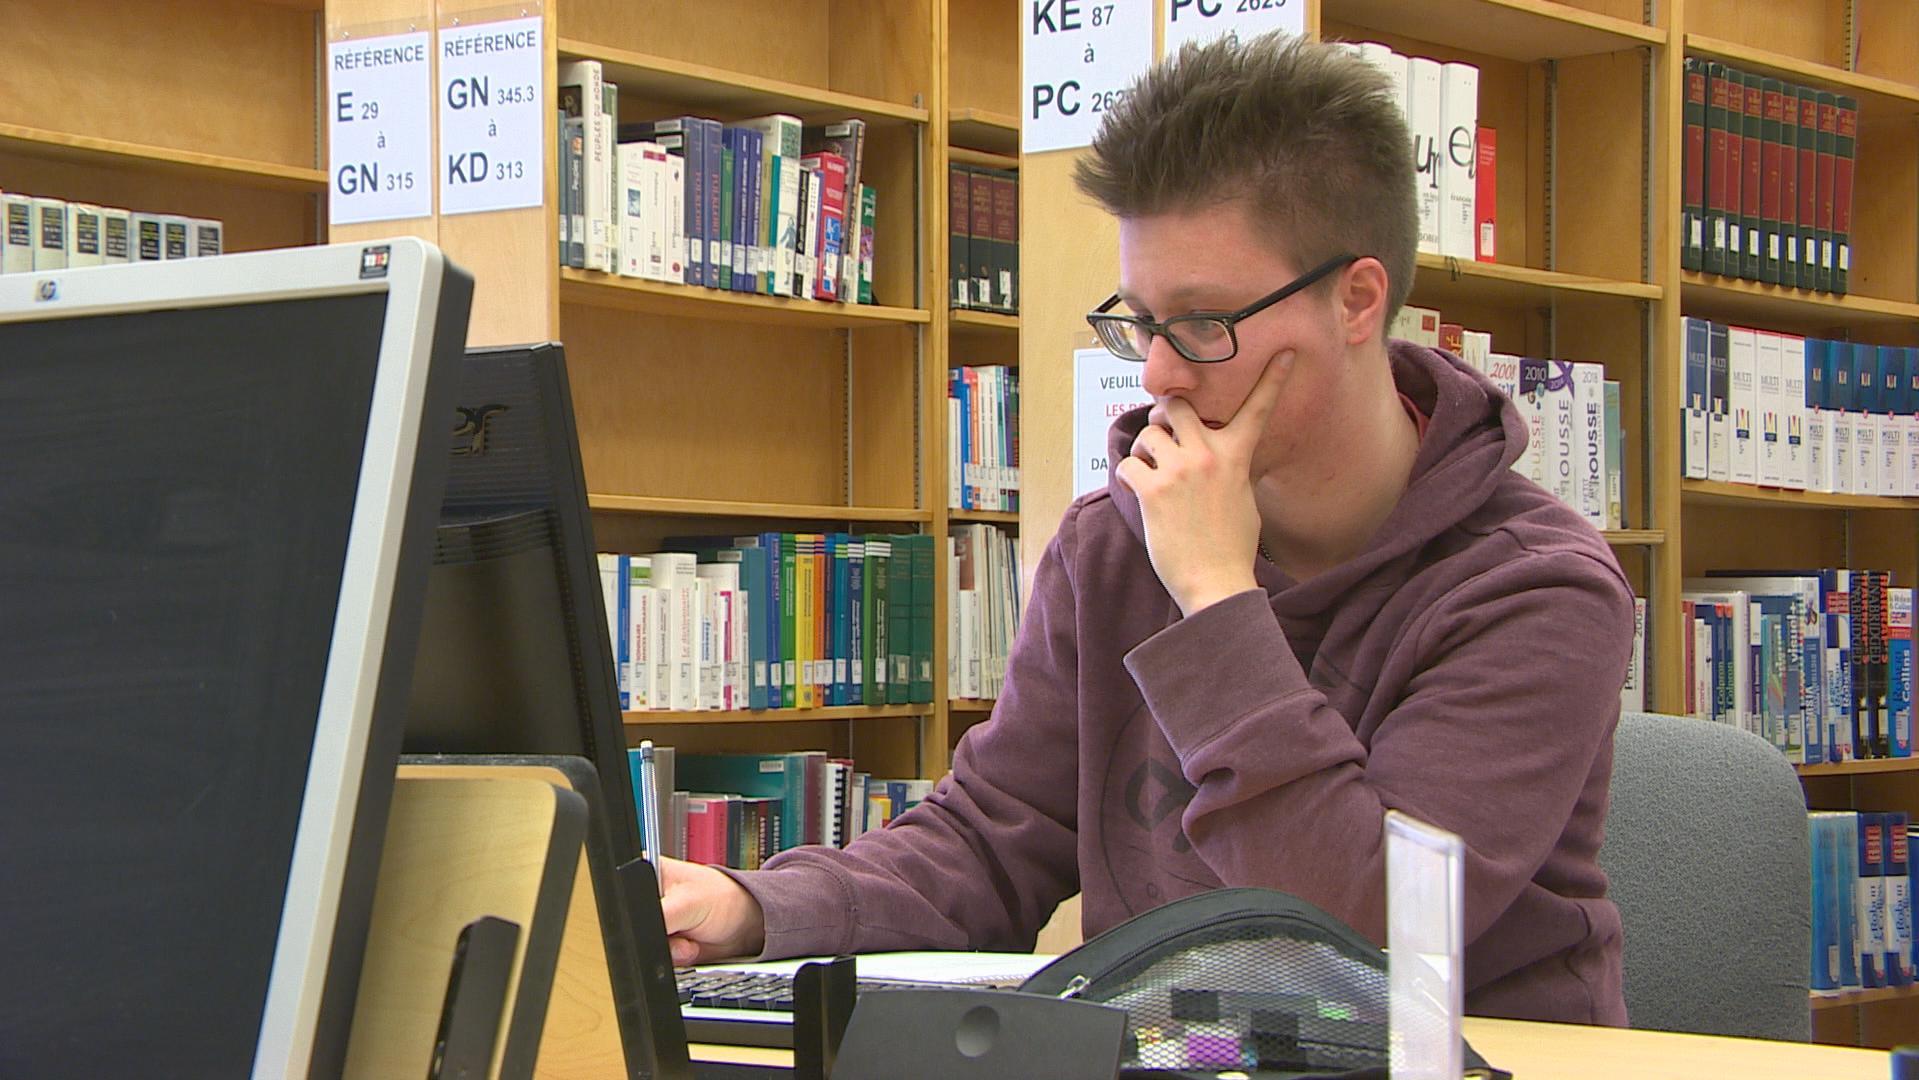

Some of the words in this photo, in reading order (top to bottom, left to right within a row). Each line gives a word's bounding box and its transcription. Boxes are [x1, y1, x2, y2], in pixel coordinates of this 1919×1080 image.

[1033, 0, 1082, 35] KE
[1092, 5, 1115, 27] 87
[1171, 0, 1223, 22] PC
[334, 44, 425, 71] RÉFÉRENCE
[444, 30, 537, 58] RÉFÉRENCE
[1084, 43, 1095, 63] à
[337, 91, 354, 122] E
[361, 102, 379, 120] 29
[447, 75, 489, 110] GN
[497, 85, 535, 105] 345.3
[1032, 80, 1081, 120] PC
[377, 131, 386, 148] à
[488, 119, 497, 137] à
[337, 162, 378, 195] GN
[387, 172, 414, 191] 315
[448, 152, 489, 185] KD
[496, 161, 524, 180] 313
[1525, 366, 1547, 381] 2010
[1105, 403, 1126, 417] LES
[1869, 571, 1880, 664] UNABRIDGED
[1902, 649, 1910, 702] Collins
